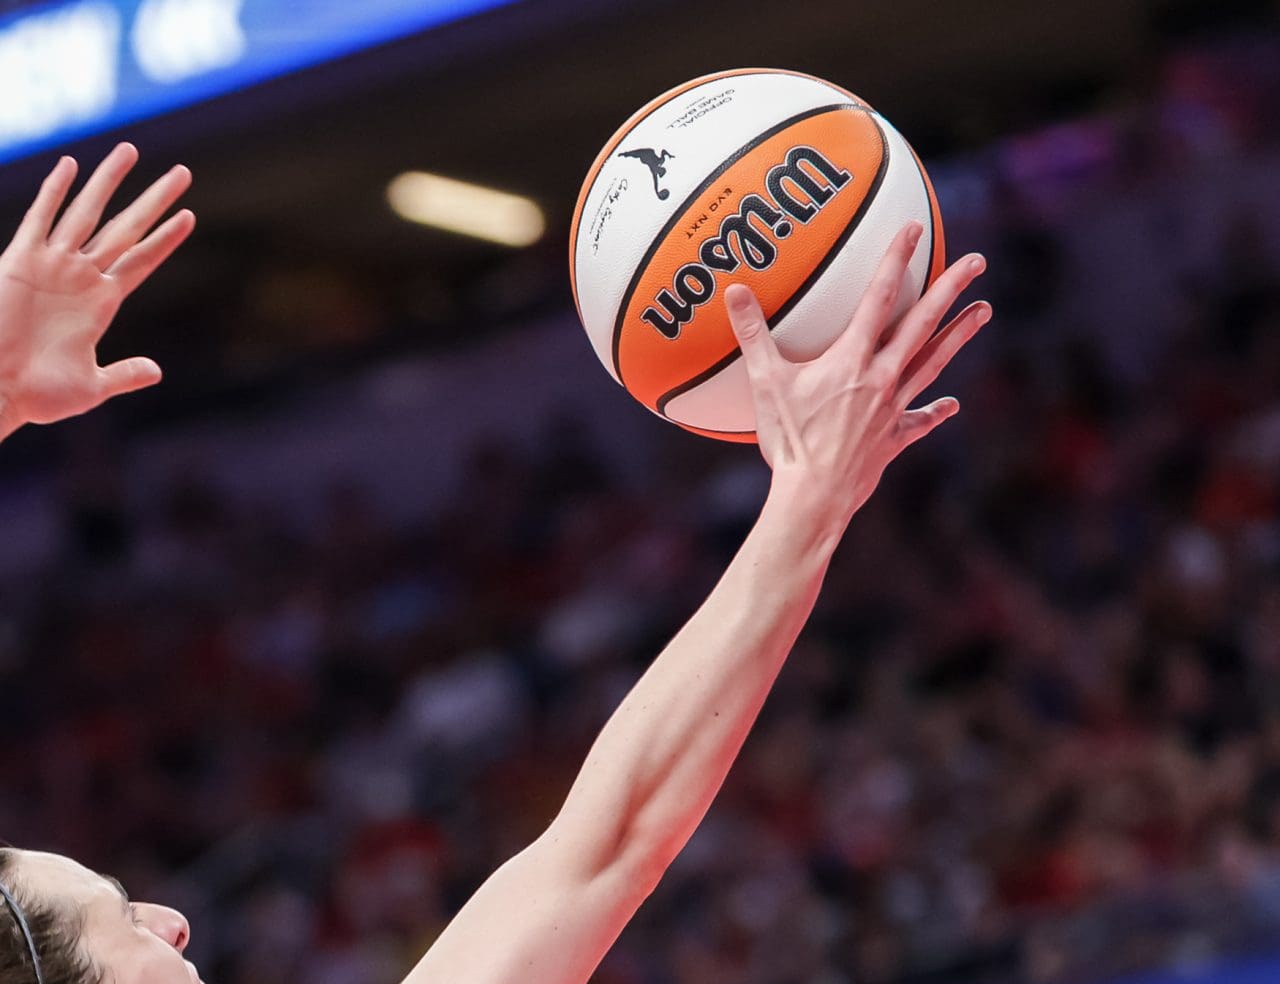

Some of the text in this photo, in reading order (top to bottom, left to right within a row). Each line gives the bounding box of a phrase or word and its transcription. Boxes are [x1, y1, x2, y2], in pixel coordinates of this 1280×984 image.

[679, 96, 733, 128] OFFICIAL
[698, 88, 735, 111] GAME
[666, 106, 699, 130] BALL
[684, 187, 733, 240] EVO NXT
[640, 145, 854, 340] Wilson
